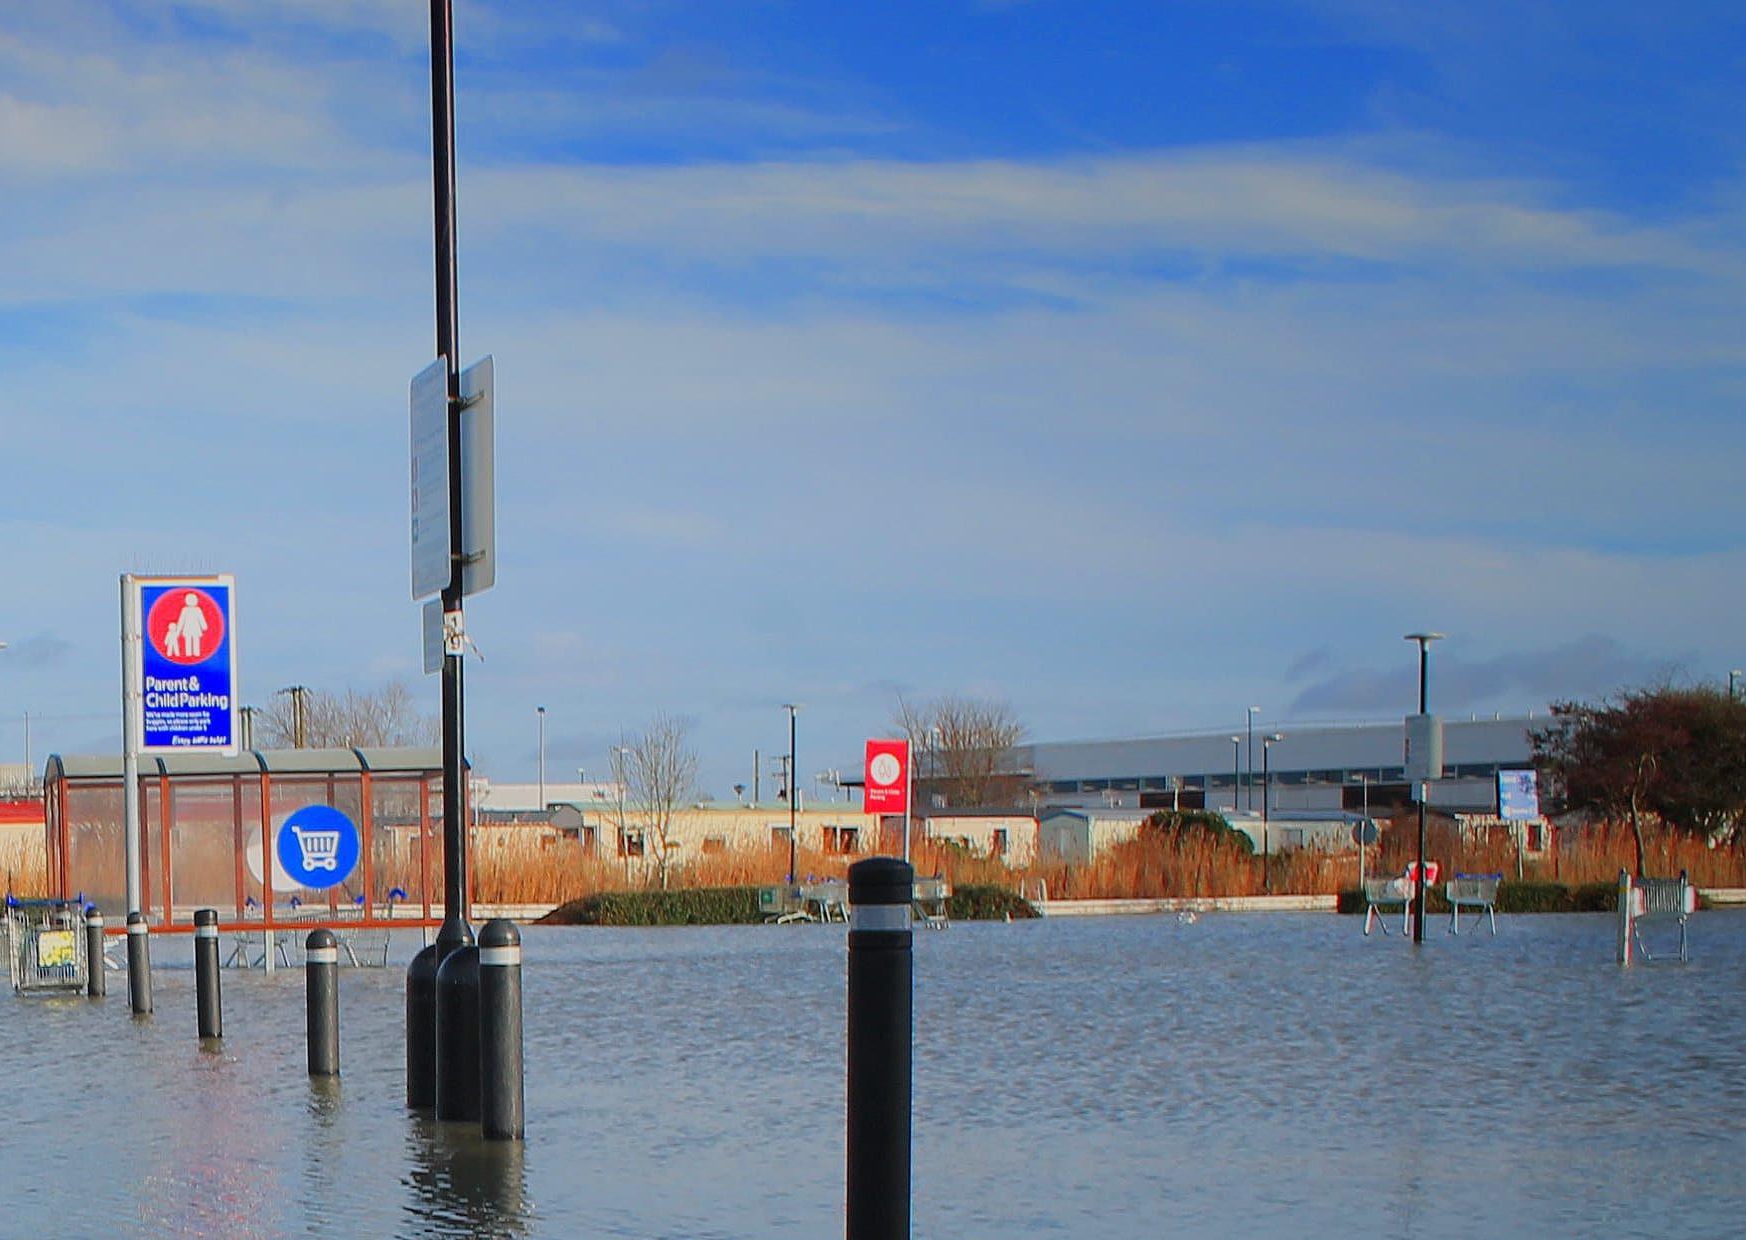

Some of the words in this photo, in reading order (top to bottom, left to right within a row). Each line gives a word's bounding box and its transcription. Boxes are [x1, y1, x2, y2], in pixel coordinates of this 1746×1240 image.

[146, 676, 188, 692] Parent
[189, 675, 200, 691] &
[146, 692, 178, 708] Child
[180, 692, 228, 710] Parking
